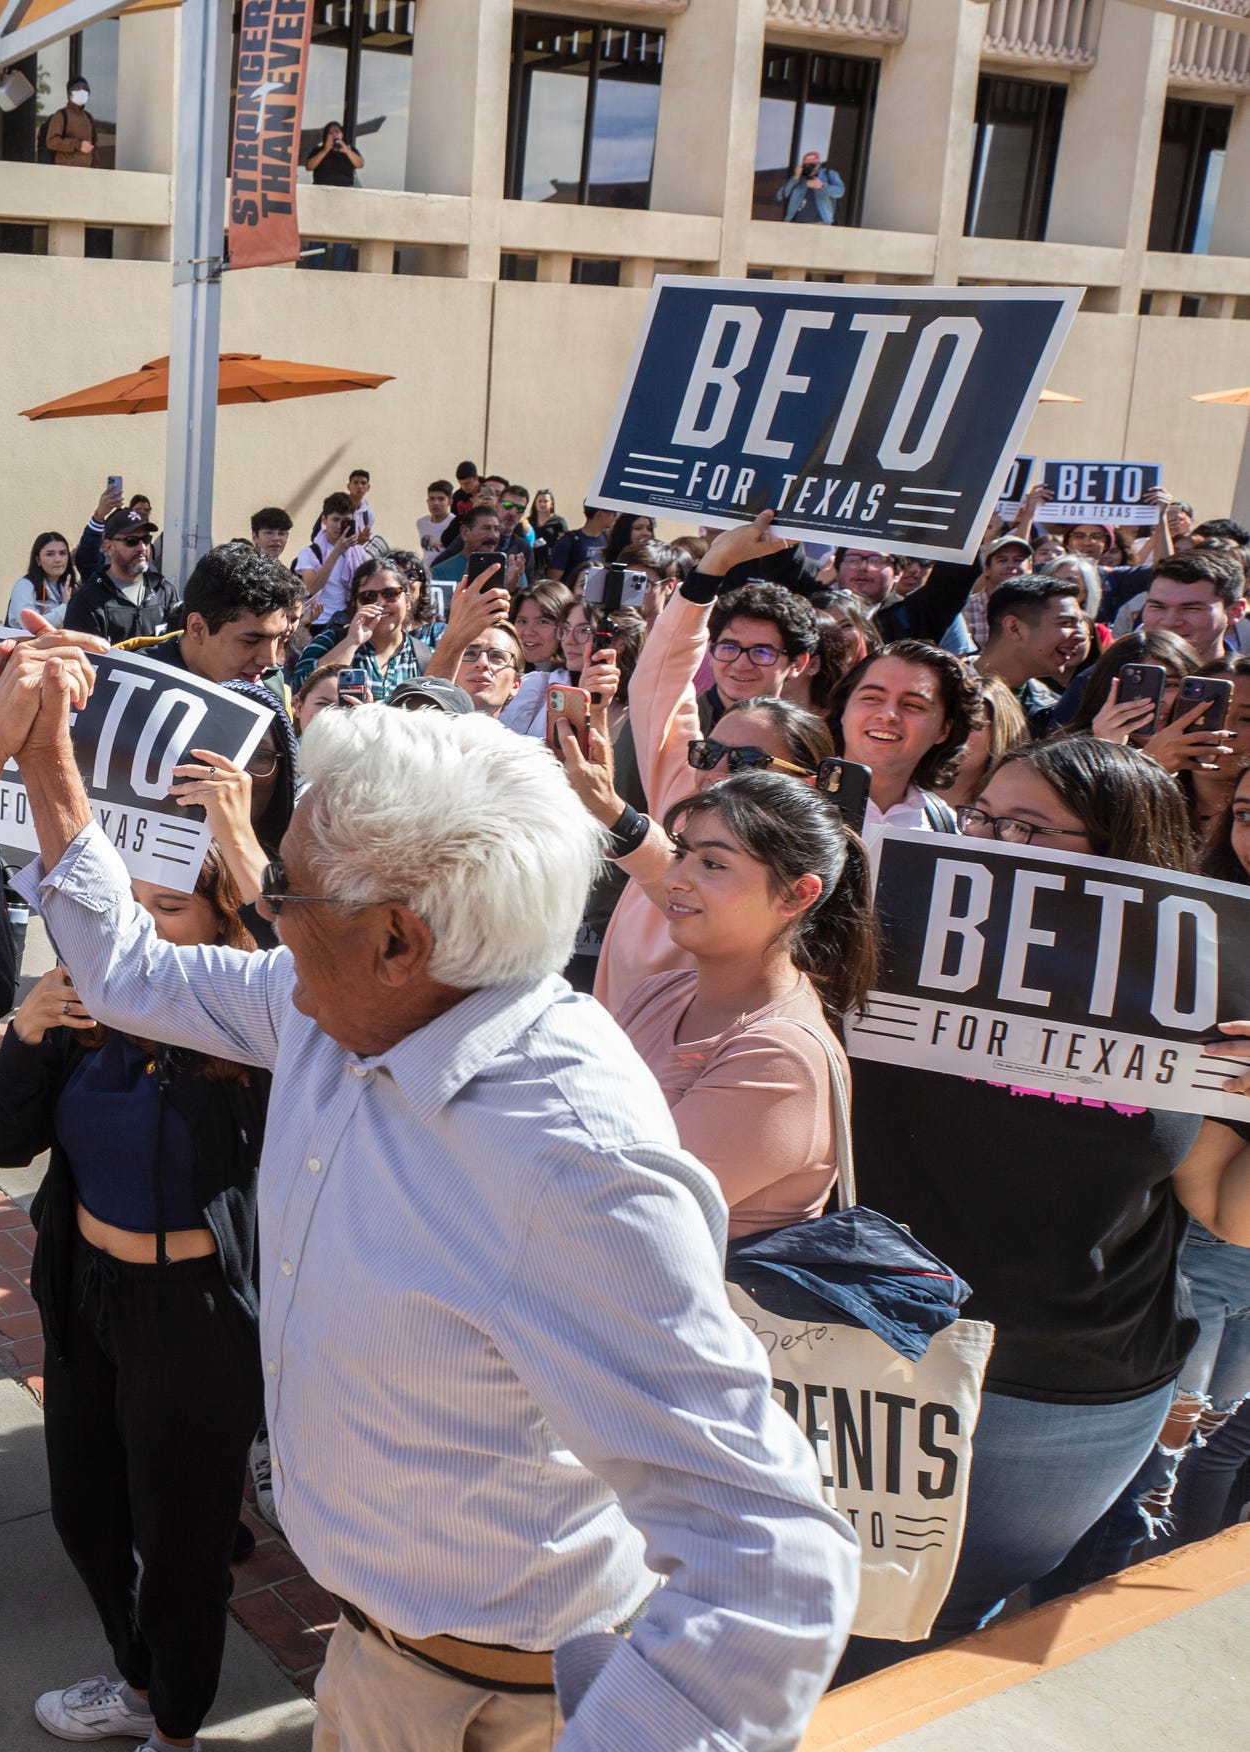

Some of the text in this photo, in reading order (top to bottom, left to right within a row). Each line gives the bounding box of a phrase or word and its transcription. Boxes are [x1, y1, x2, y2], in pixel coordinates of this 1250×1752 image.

[232, 0, 272, 227] STRONGER
[261, 104, 297, 219] THAN
[671, 304, 983, 472] BETO
[686, 461, 756, 506] FOR
[776, 473, 886, 522] TEXAS
[1057, 465, 1143, 503] BETO
[1062, 505, 1132, 518] FOR TEXAS
[0, 788, 148, 853] FO XAS
[918, 858, 1219, 1032] BETO
[931, 1010, 1179, 1084] FOR TEXAS
